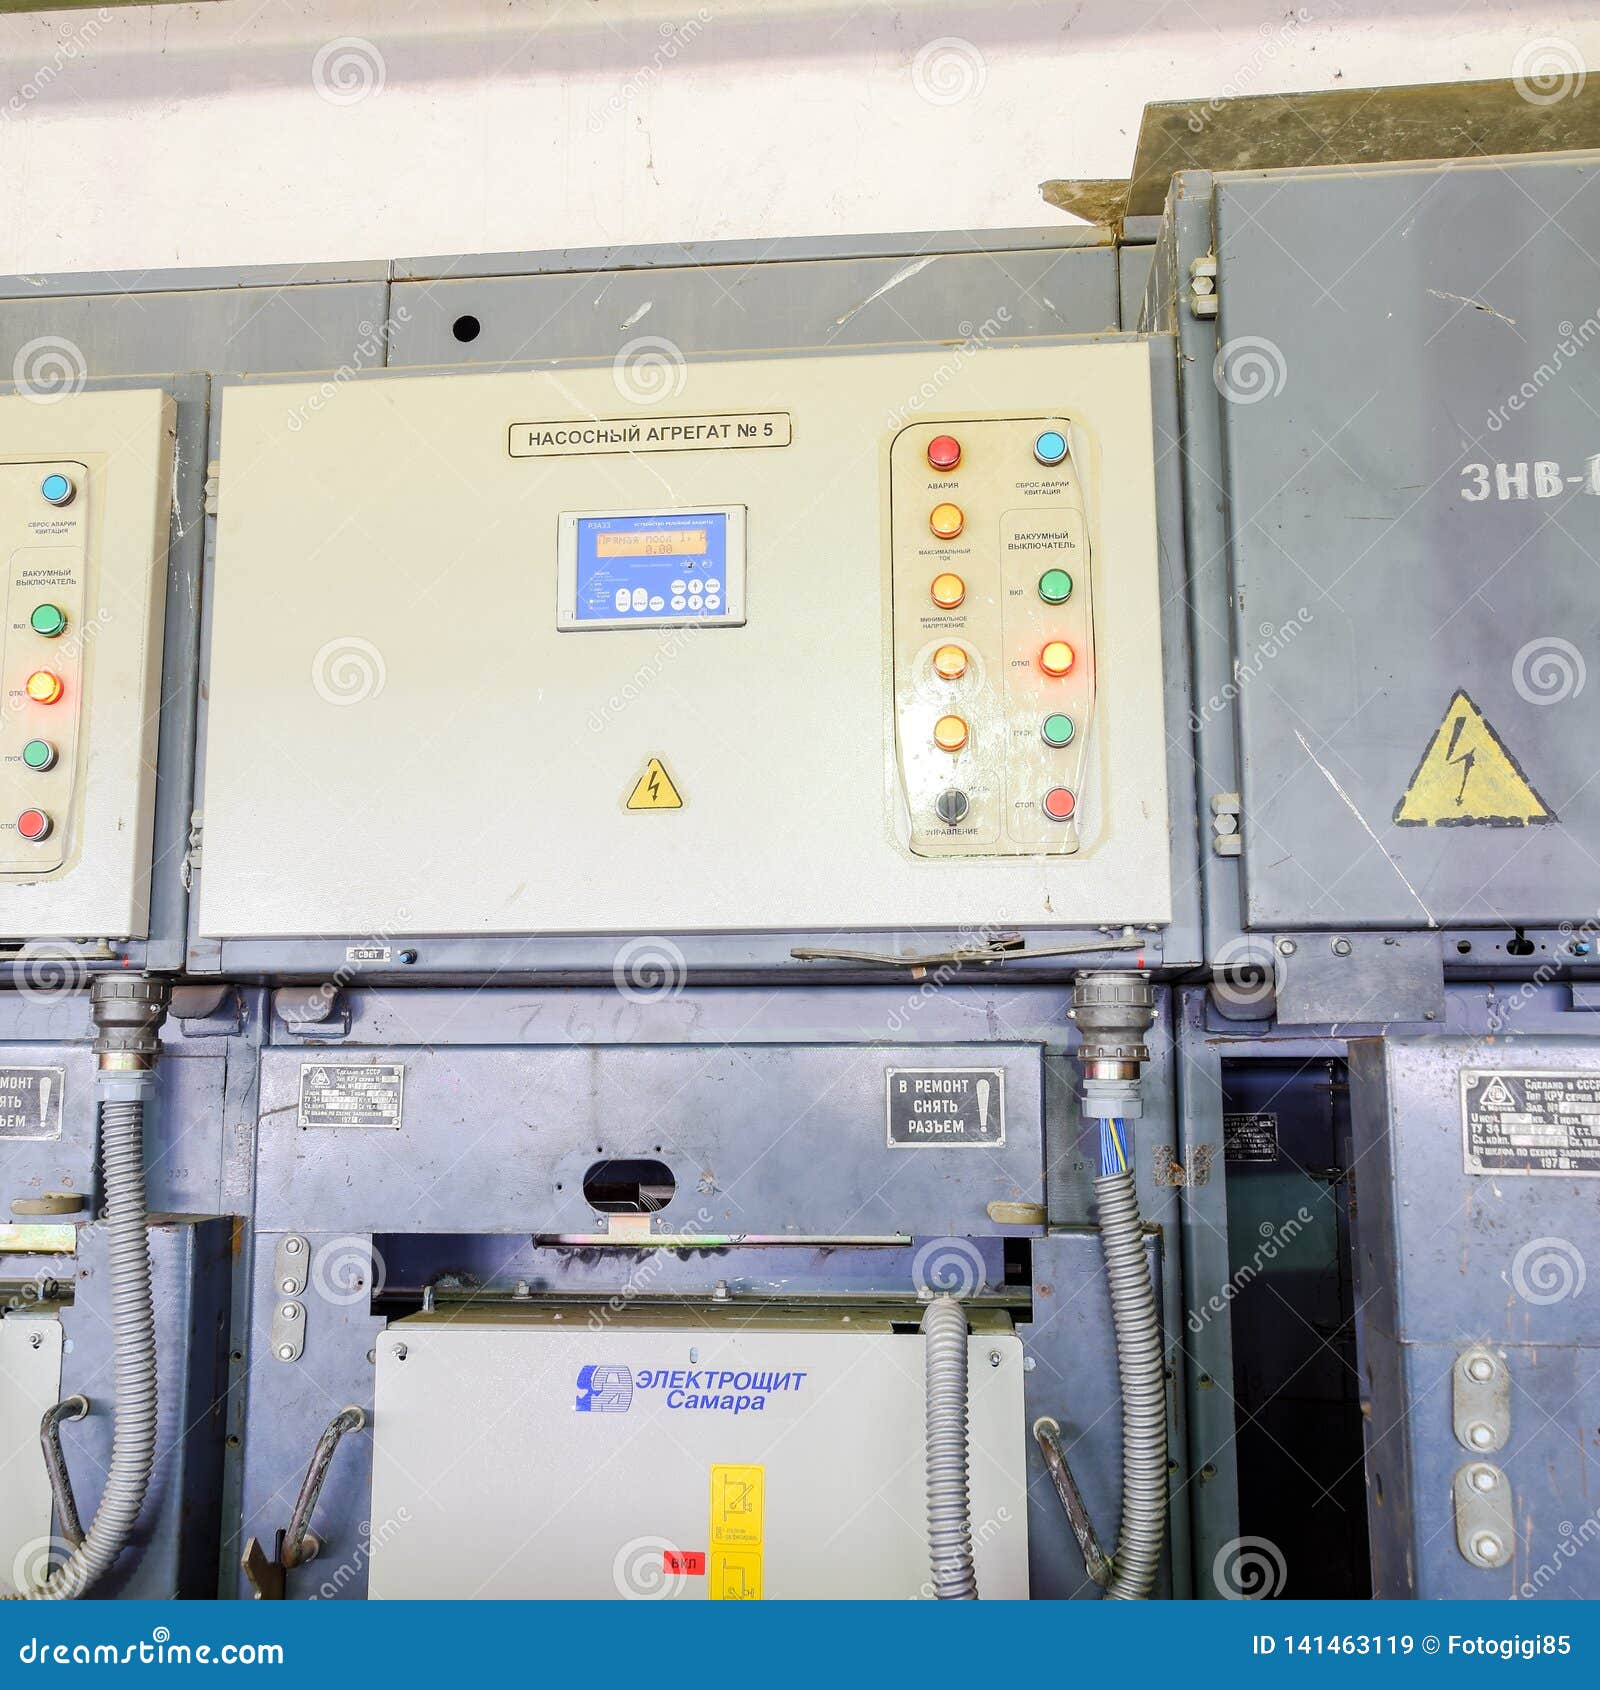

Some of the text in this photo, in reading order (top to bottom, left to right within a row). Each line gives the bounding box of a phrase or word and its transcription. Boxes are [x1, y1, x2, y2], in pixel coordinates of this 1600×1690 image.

[528, 423, 773, 446] НАСОСНЫЙ АГРЕГАТ № 5
[1014, 532, 1069, 540] ВАКУУМНЫЙ
[1008, 542, 1076, 550] ВЫКЛЮЧАТЕЛЬ
[23, 569, 71, 577] ВАКУУМНЫЙ
[358, 950, 379, 958] СВЕТ
[899, 1080, 968, 1093] В РЕМОНТ
[914, 1100, 958, 1113] СНЯТЬ
[908, 1120, 964, 1133] РАЗЪЕМ
[636, 1370, 807, 1392] ЭЛЕКТРОЩИТ
[667, 1390, 765, 1414] Самара
[672, 1558, 696, 1568] ВКЛ
